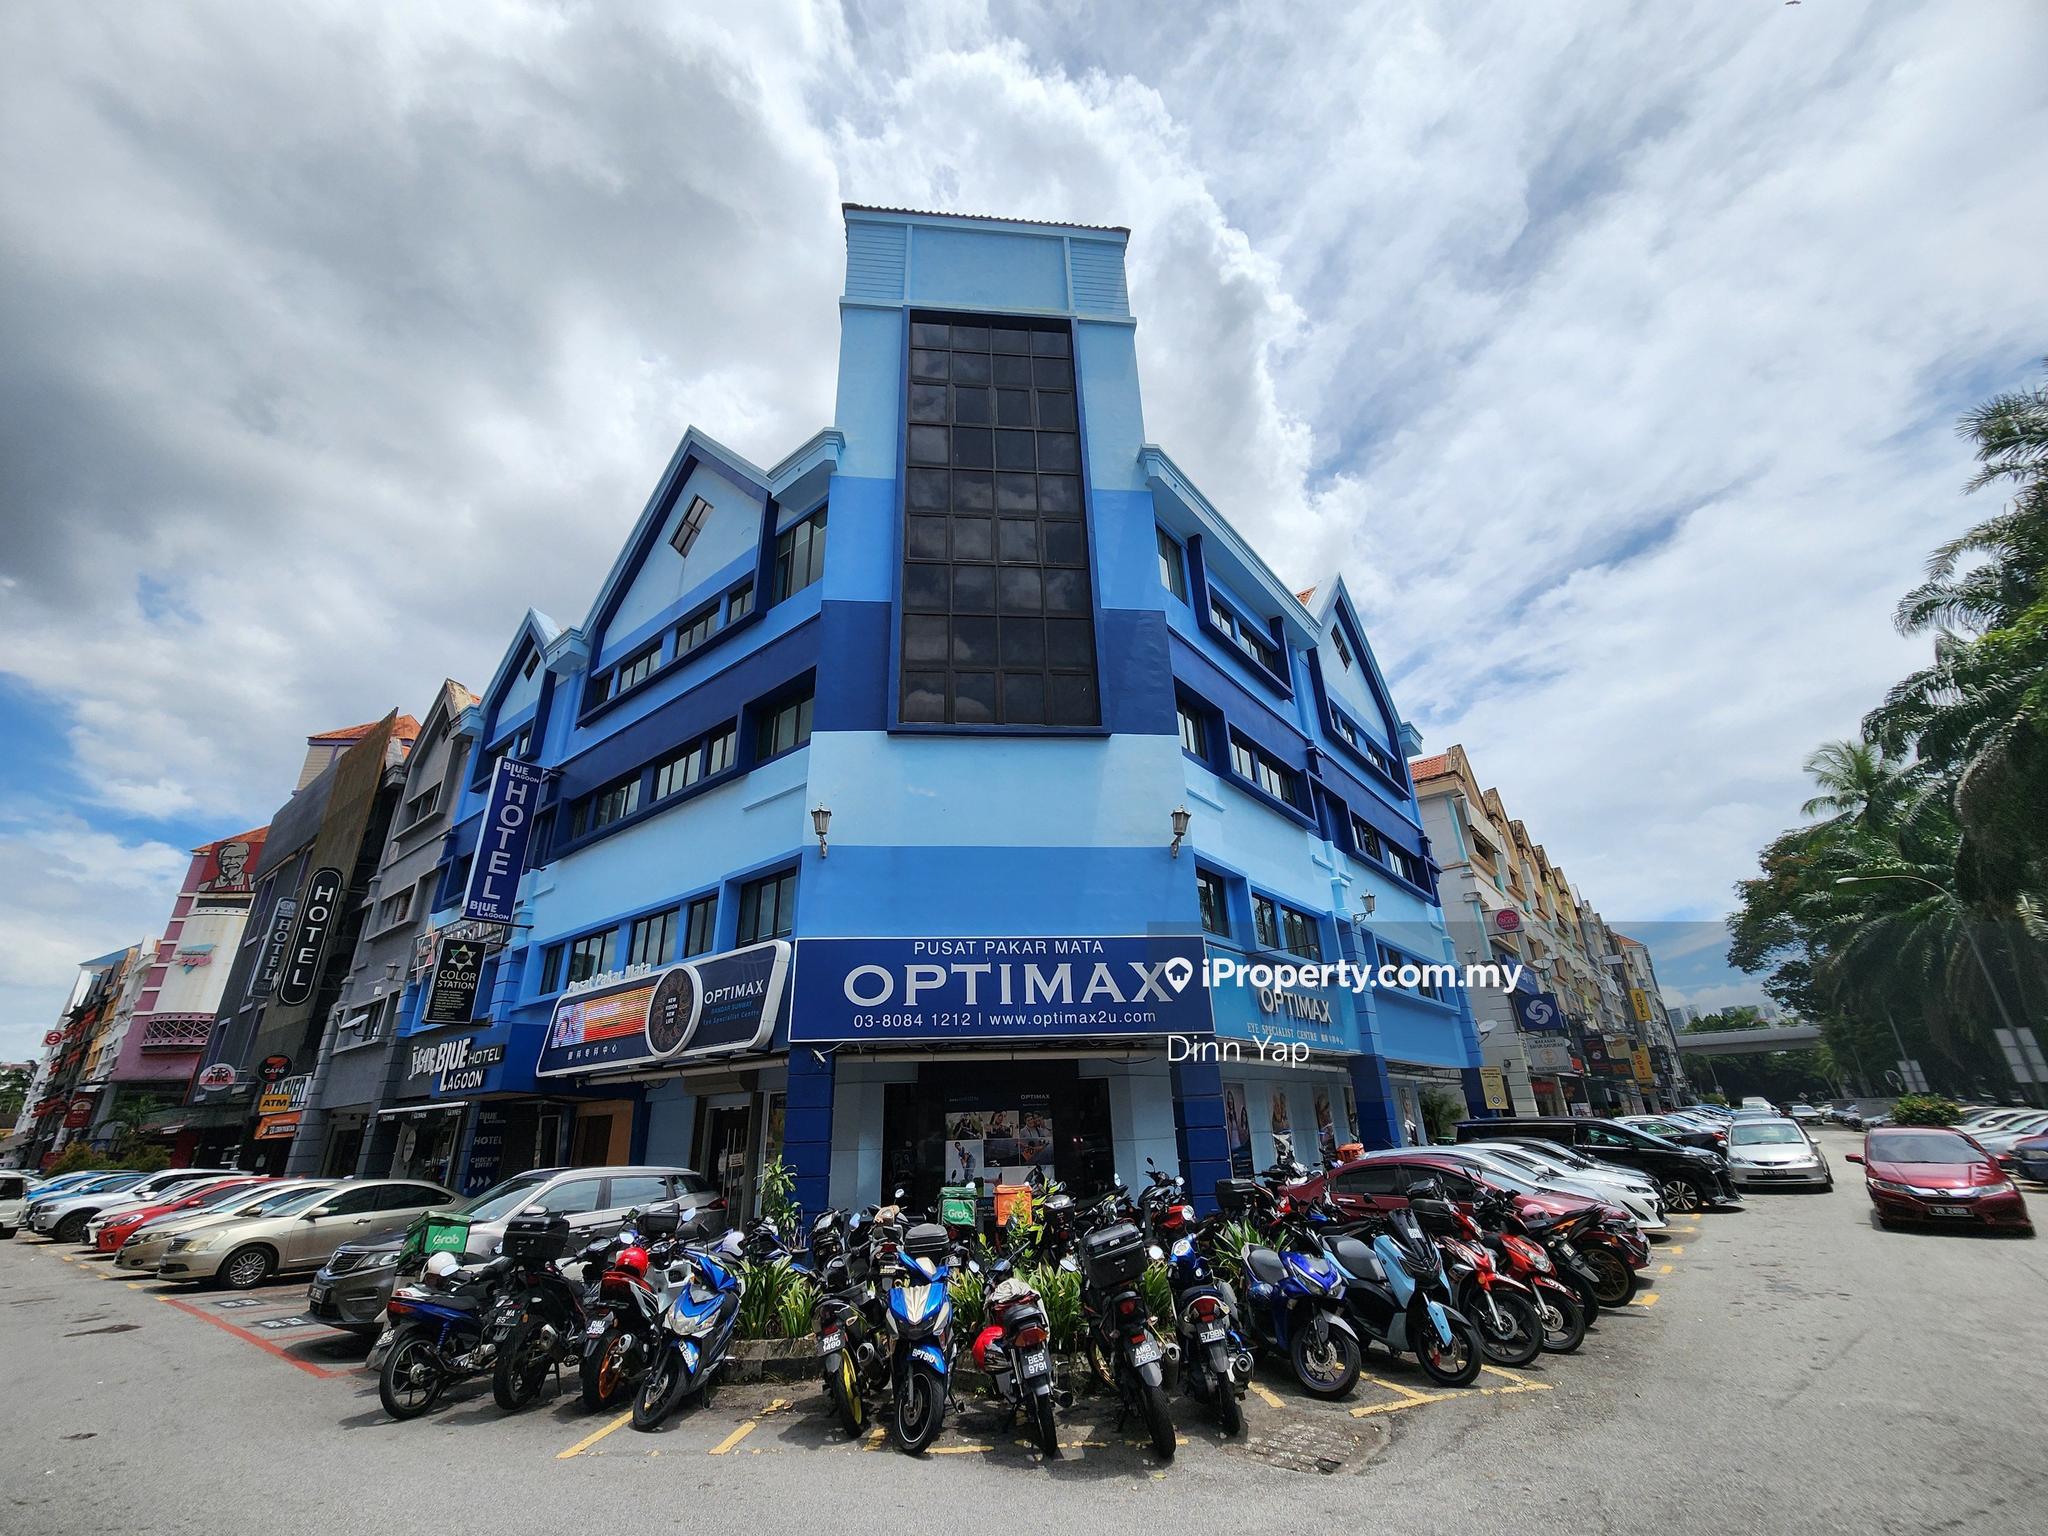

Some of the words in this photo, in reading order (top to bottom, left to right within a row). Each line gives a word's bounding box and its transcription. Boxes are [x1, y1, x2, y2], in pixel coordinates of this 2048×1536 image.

[503, 761, 530, 777] BLUE
[510, 772, 540, 784] LAGOON
[482, 780, 528, 900] HOTEL
[469, 900, 498, 915] BLUE
[476, 910, 510, 921] LAGOON
[292, 885, 334, 986] HOTEL
[263, 919, 292, 980] HOTEL
[914, 941, 977, 955] PUSAT
[985, 940, 1047, 955] PAKAR
[1055, 940, 1104, 954] MATA
[439, 970, 477, 982] COLOR
[437, 980, 475, 990] STATION
[704, 979, 764, 1004] OPTIMAX
[843, 962, 1174, 1007] OPTIMAX
[1260, 987, 1333, 1024] OPTIMAX
[853, 1013, 923, 1028] 03-8084
[932, 1012, 971, 1026] 1212
[989, 1010, 1156, 1028] www.optimax2u.com
[434, 1037, 471, 1073] BLUE
[467, 1048, 500, 1065] HOTEL
[439, 1069, 484, 1092] LAGOON
[262, 1099, 288, 1107] ATM
[473, 1136, 503, 1146] HOTEL
[947, 1209, 969, 1219] Grab
[432, 1234, 460, 1245] Grab
